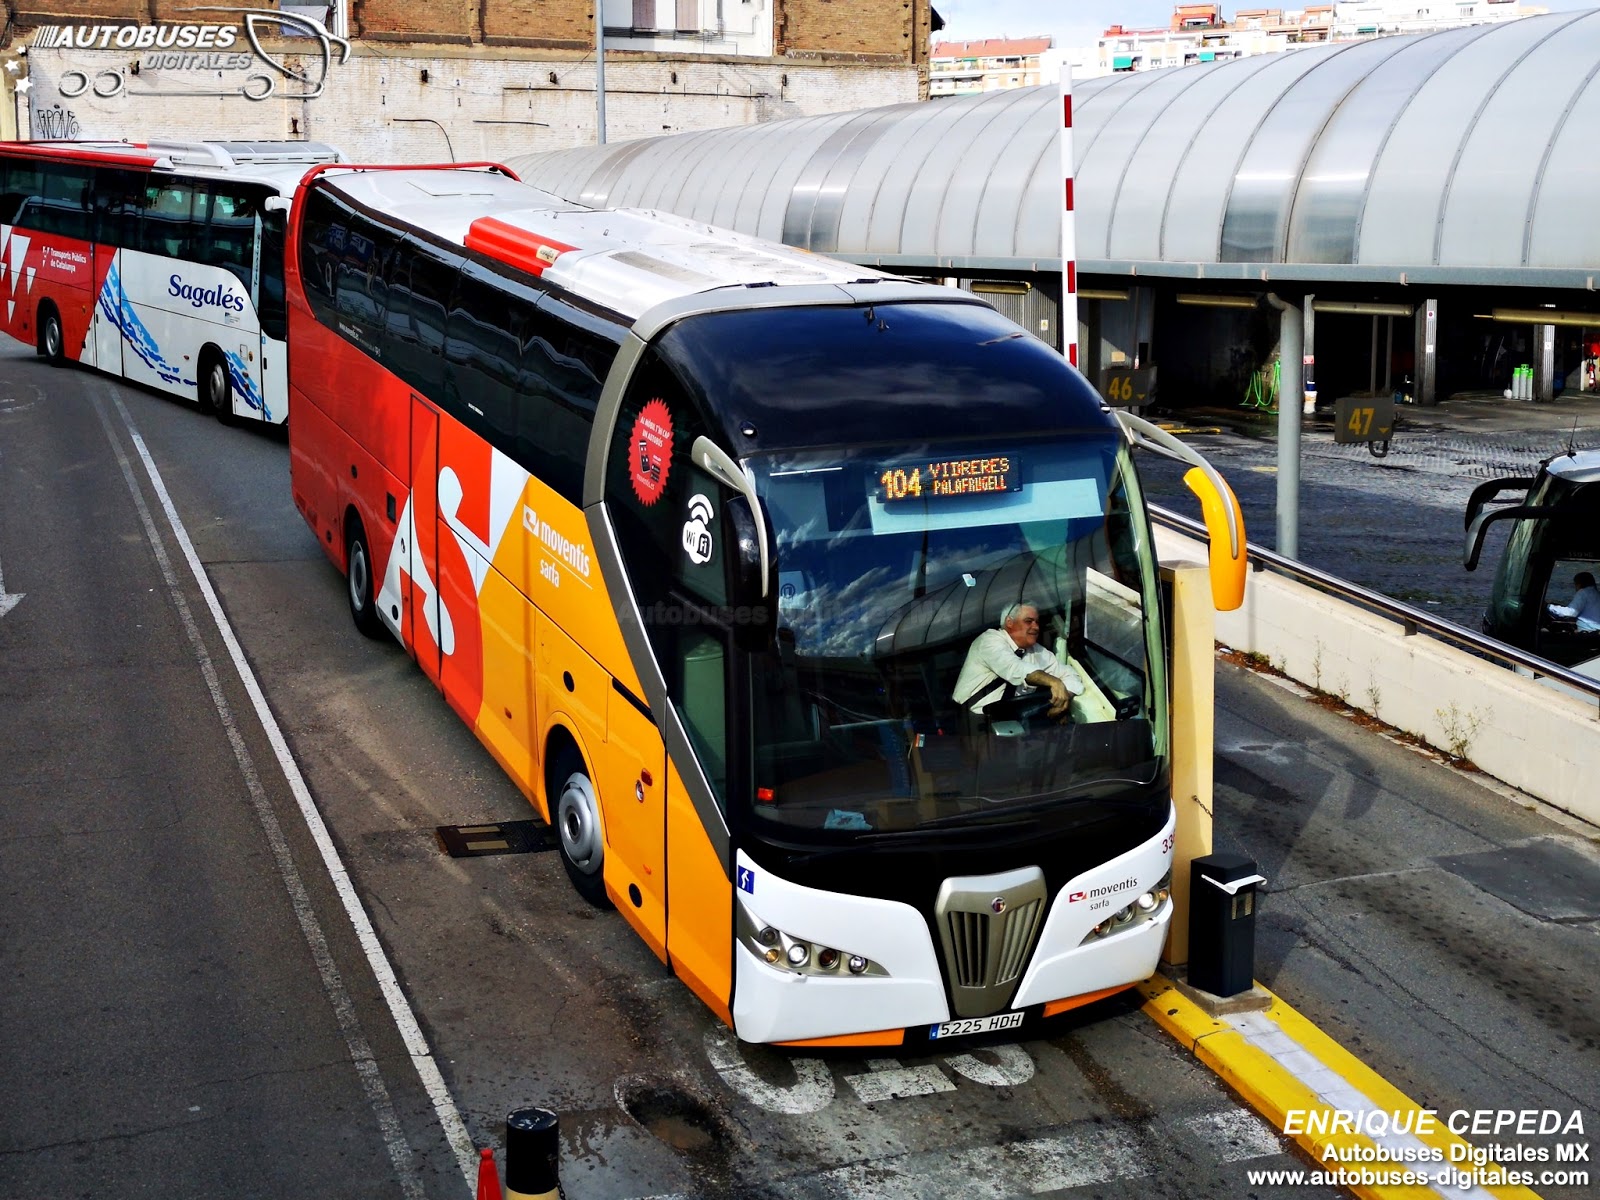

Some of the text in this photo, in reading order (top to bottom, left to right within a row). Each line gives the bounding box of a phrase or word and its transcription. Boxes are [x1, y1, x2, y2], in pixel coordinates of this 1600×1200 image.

[168, 274, 244, 312] Sagalés
[1108, 376, 1132, 400] 46
[1348, 408, 1374, 435] 47
[881, 458, 1010, 499] 104 VIDRERES
[933, 475, 1007, 495] PALAFRUGELL
[541, 521, 590, 578] moventis
[540, 559, 560, 588] sarfa
[1089, 877, 1138, 898] moventis
[1089, 899, 1110, 911] sarfa
[941, 1014, 1021, 1036] 5225 HDH
